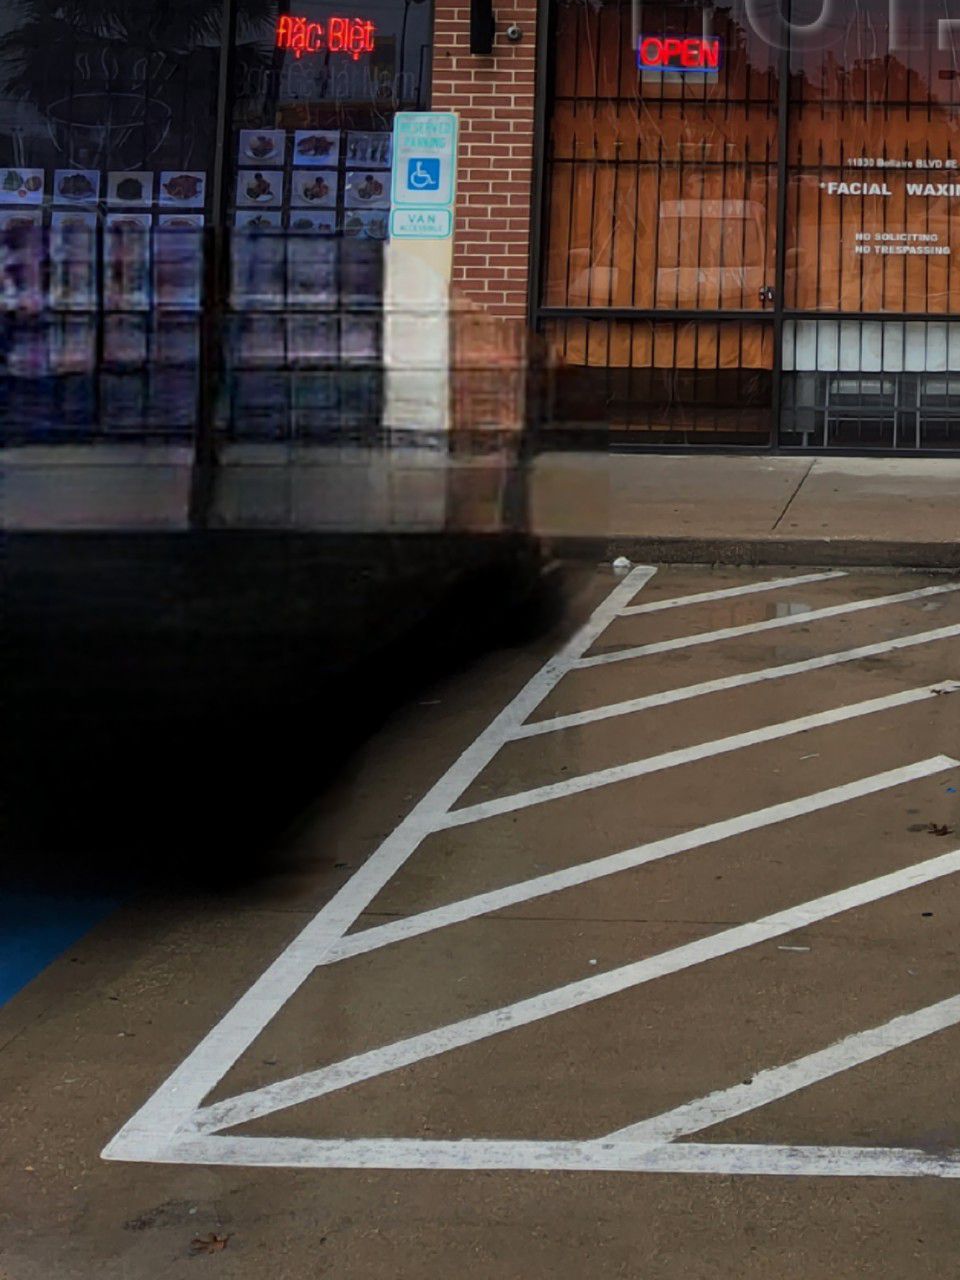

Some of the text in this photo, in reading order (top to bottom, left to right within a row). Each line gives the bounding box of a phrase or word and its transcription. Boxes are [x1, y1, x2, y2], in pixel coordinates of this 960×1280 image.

[640, 37, 719, 67] OPEN
[915, 158, 942, 168] BLVD
[408, 214, 435, 224] VAN
[855, 233, 870, 241] NO
[855, 246, 951, 255] NO TRESPASSING
